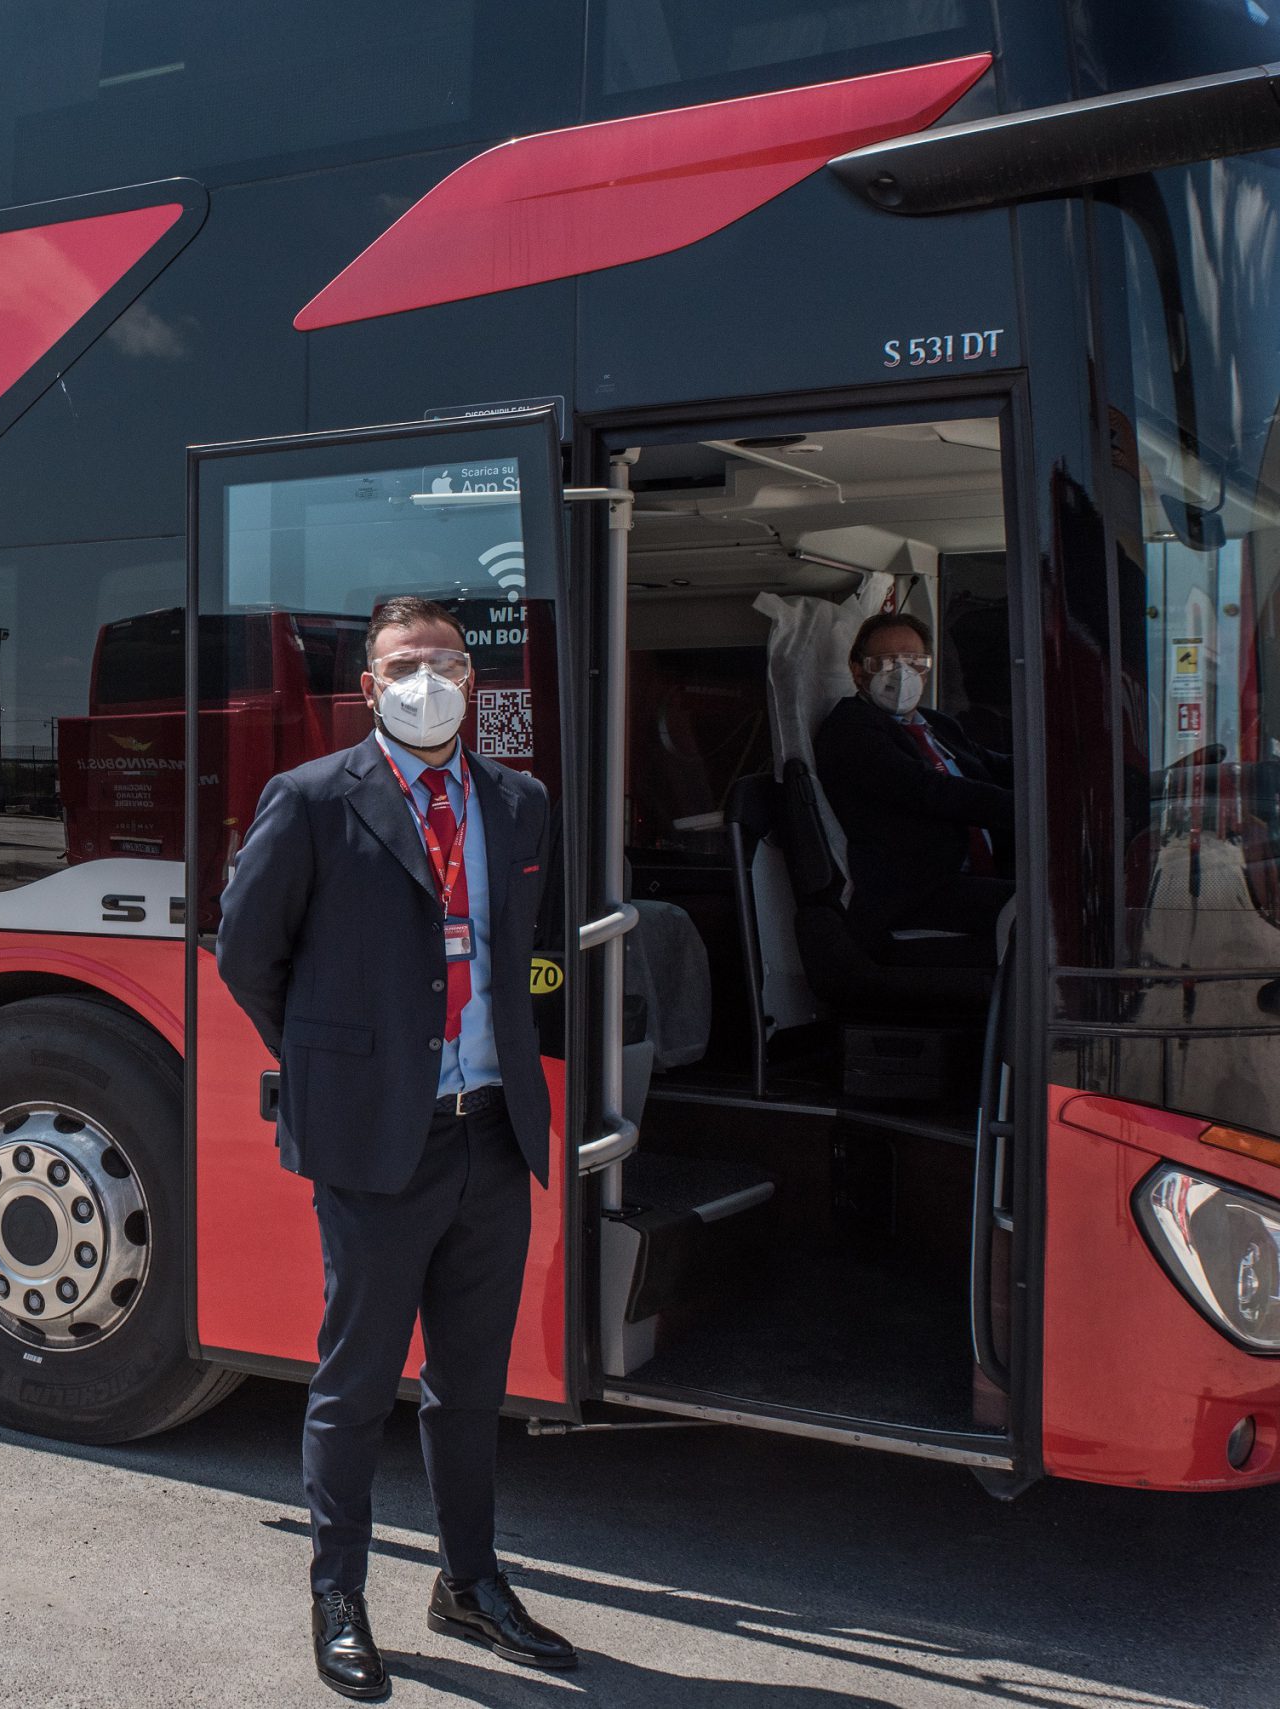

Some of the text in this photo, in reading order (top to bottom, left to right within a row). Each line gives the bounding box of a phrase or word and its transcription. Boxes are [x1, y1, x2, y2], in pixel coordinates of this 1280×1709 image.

[883, 329, 1004, 368] S 531 DT
[461, 466, 514, 478] Scarica su
[465, 630, 492, 646] ON
[530, 966, 558, 987] 70
